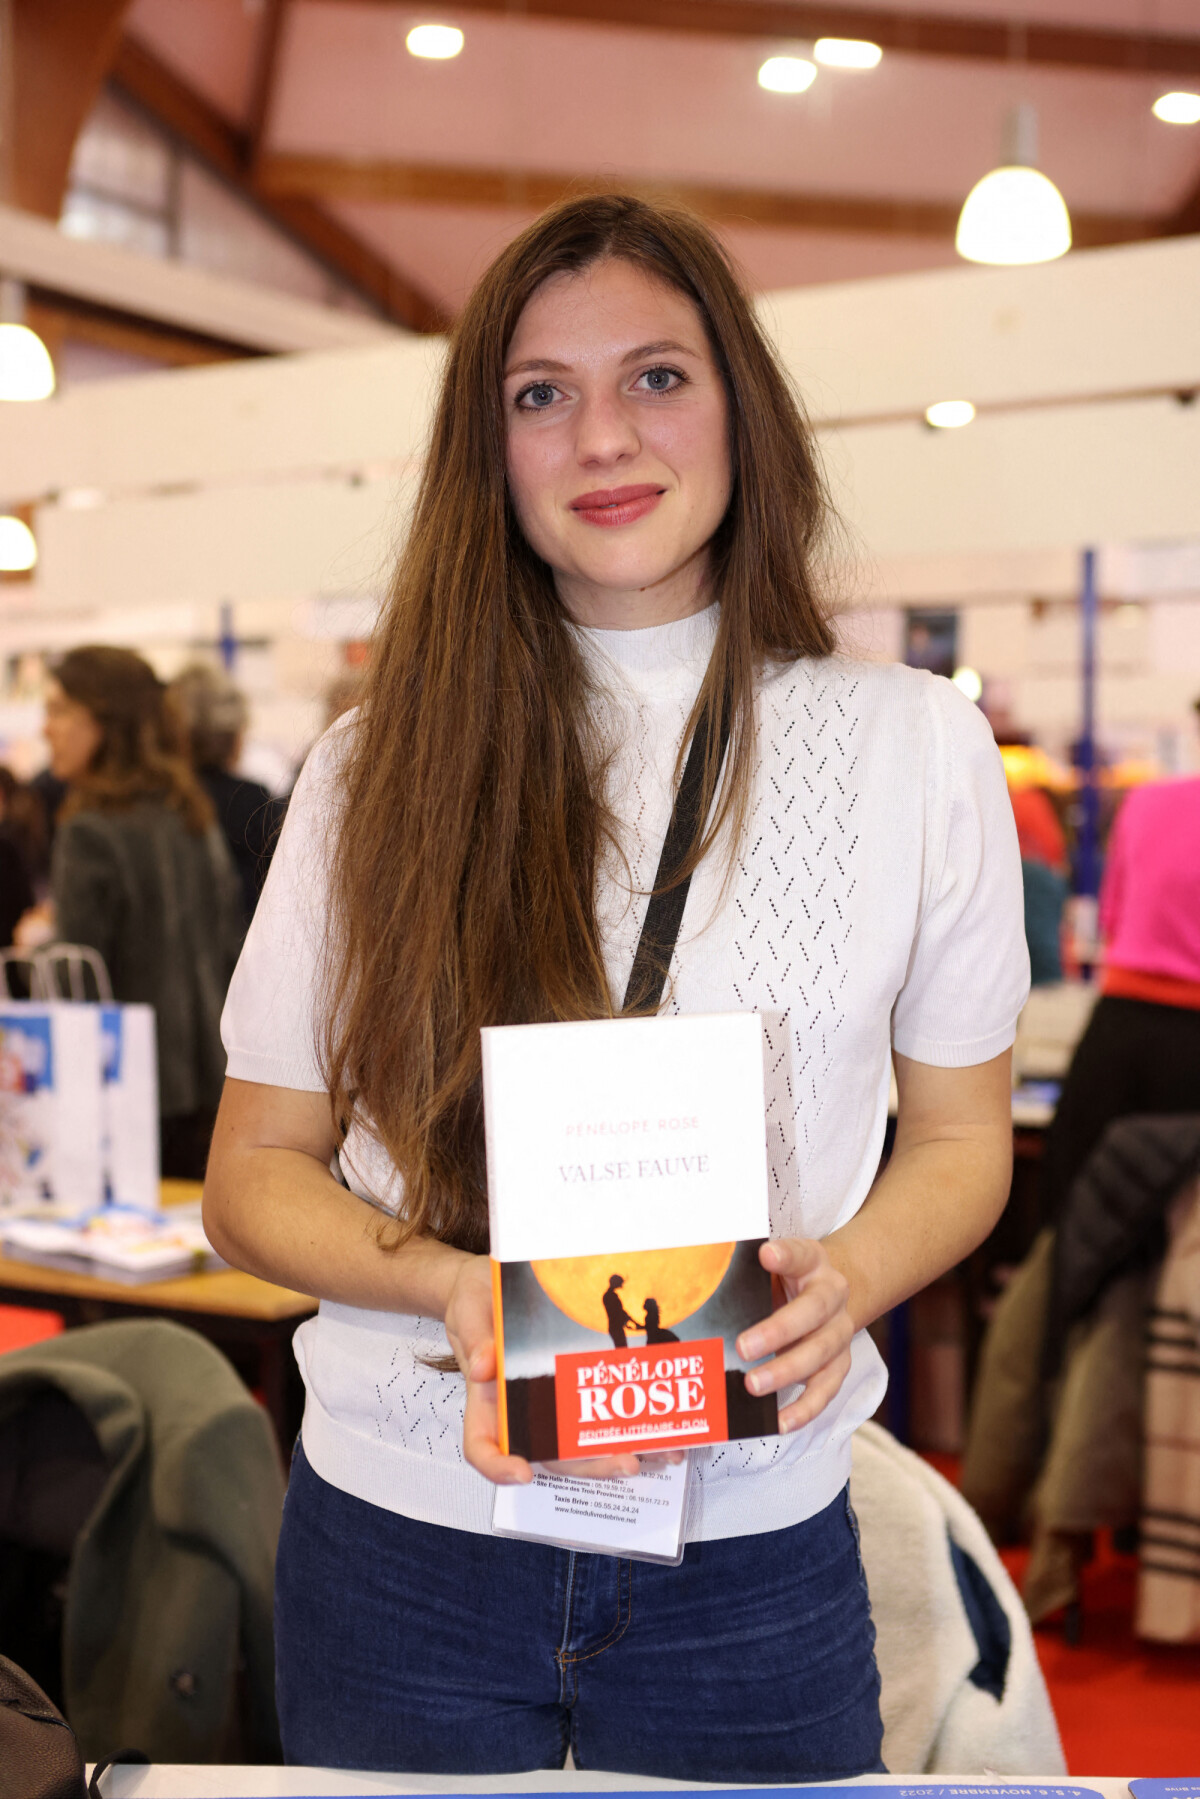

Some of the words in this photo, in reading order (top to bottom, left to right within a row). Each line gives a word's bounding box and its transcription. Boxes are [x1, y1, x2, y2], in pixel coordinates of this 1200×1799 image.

[658, 1116, 700, 1131] ROSE
[559, 1161, 630, 1183] VALSE
[637, 1155, 711, 1179] FAUVE
[577, 1355, 704, 1387] PÉNÉLOPE
[577, 1376, 706, 1423] ROSE
[579, 1426, 621, 1440] RENTRÉE
[622, 1421, 674, 1436] LITTÉRAIRE
[681, 1418, 708, 1430] PLON
[536, 1480, 548, 1488] Site
[548, 1481, 568, 1490] Espace
[596, 1490, 625, 1500] Provinces
[537, 1473, 549, 1481] Site
[549, 1475, 563, 1483] Halle
[564, 1478, 590, 1487] Brassens
[554, 1495, 571, 1504] Taxis
[571, 1497, 589, 1506] Brive
[593, 1501, 640, 1514] 05.55.24.24.24
[949, 1788, 1032, 1796] NOVEMBRE
